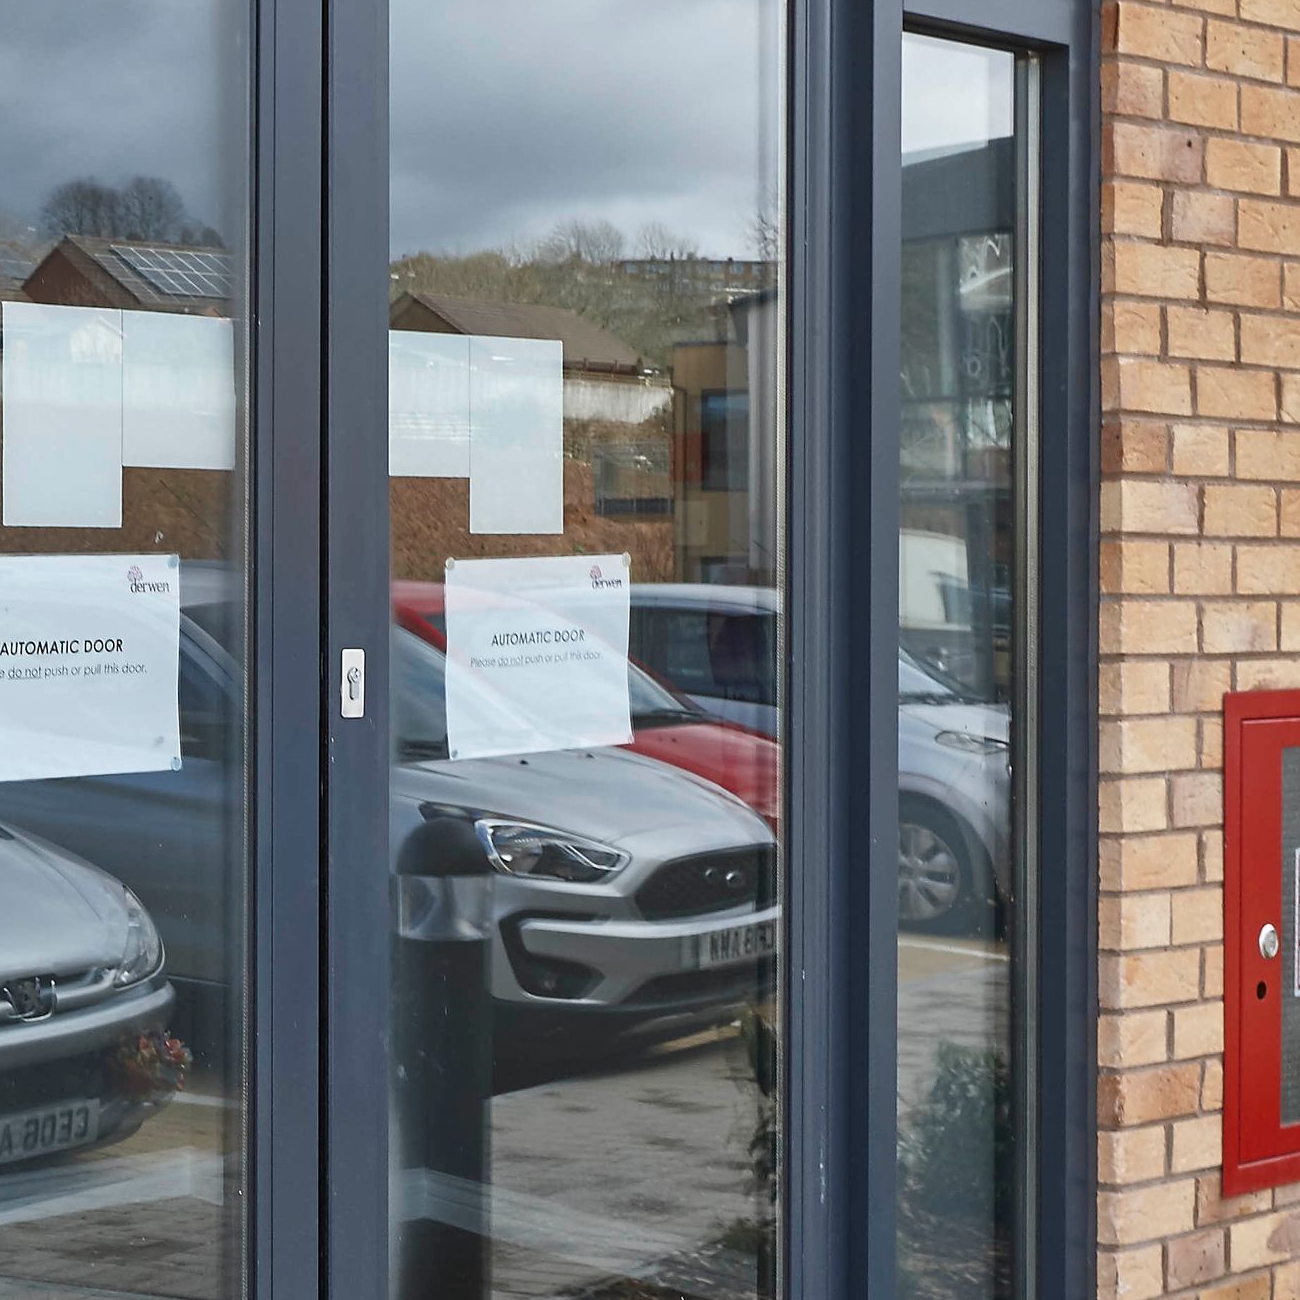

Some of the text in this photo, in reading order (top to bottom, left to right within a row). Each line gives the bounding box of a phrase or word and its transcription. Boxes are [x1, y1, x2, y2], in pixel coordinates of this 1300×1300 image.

[130, 579, 170, 593] derwen
[491, 629, 585, 647] AUTOMATIC DOOR
[0, 639, 123, 656] AUTOMATIC DOOR
[470, 656, 496, 668] Please
[497, 656, 509, 668] do
[510, 654, 524, 667] not
[525, 654, 544, 666] push
[8, 666, 22, 679] do
[24, 666, 41, 679] not
[44, 664, 68, 679] push
[71, 666, 81, 676] or
[83, 664, 101, 677] pull
[104, 662, 119, 674] this
[121, 662, 147, 674] door.
